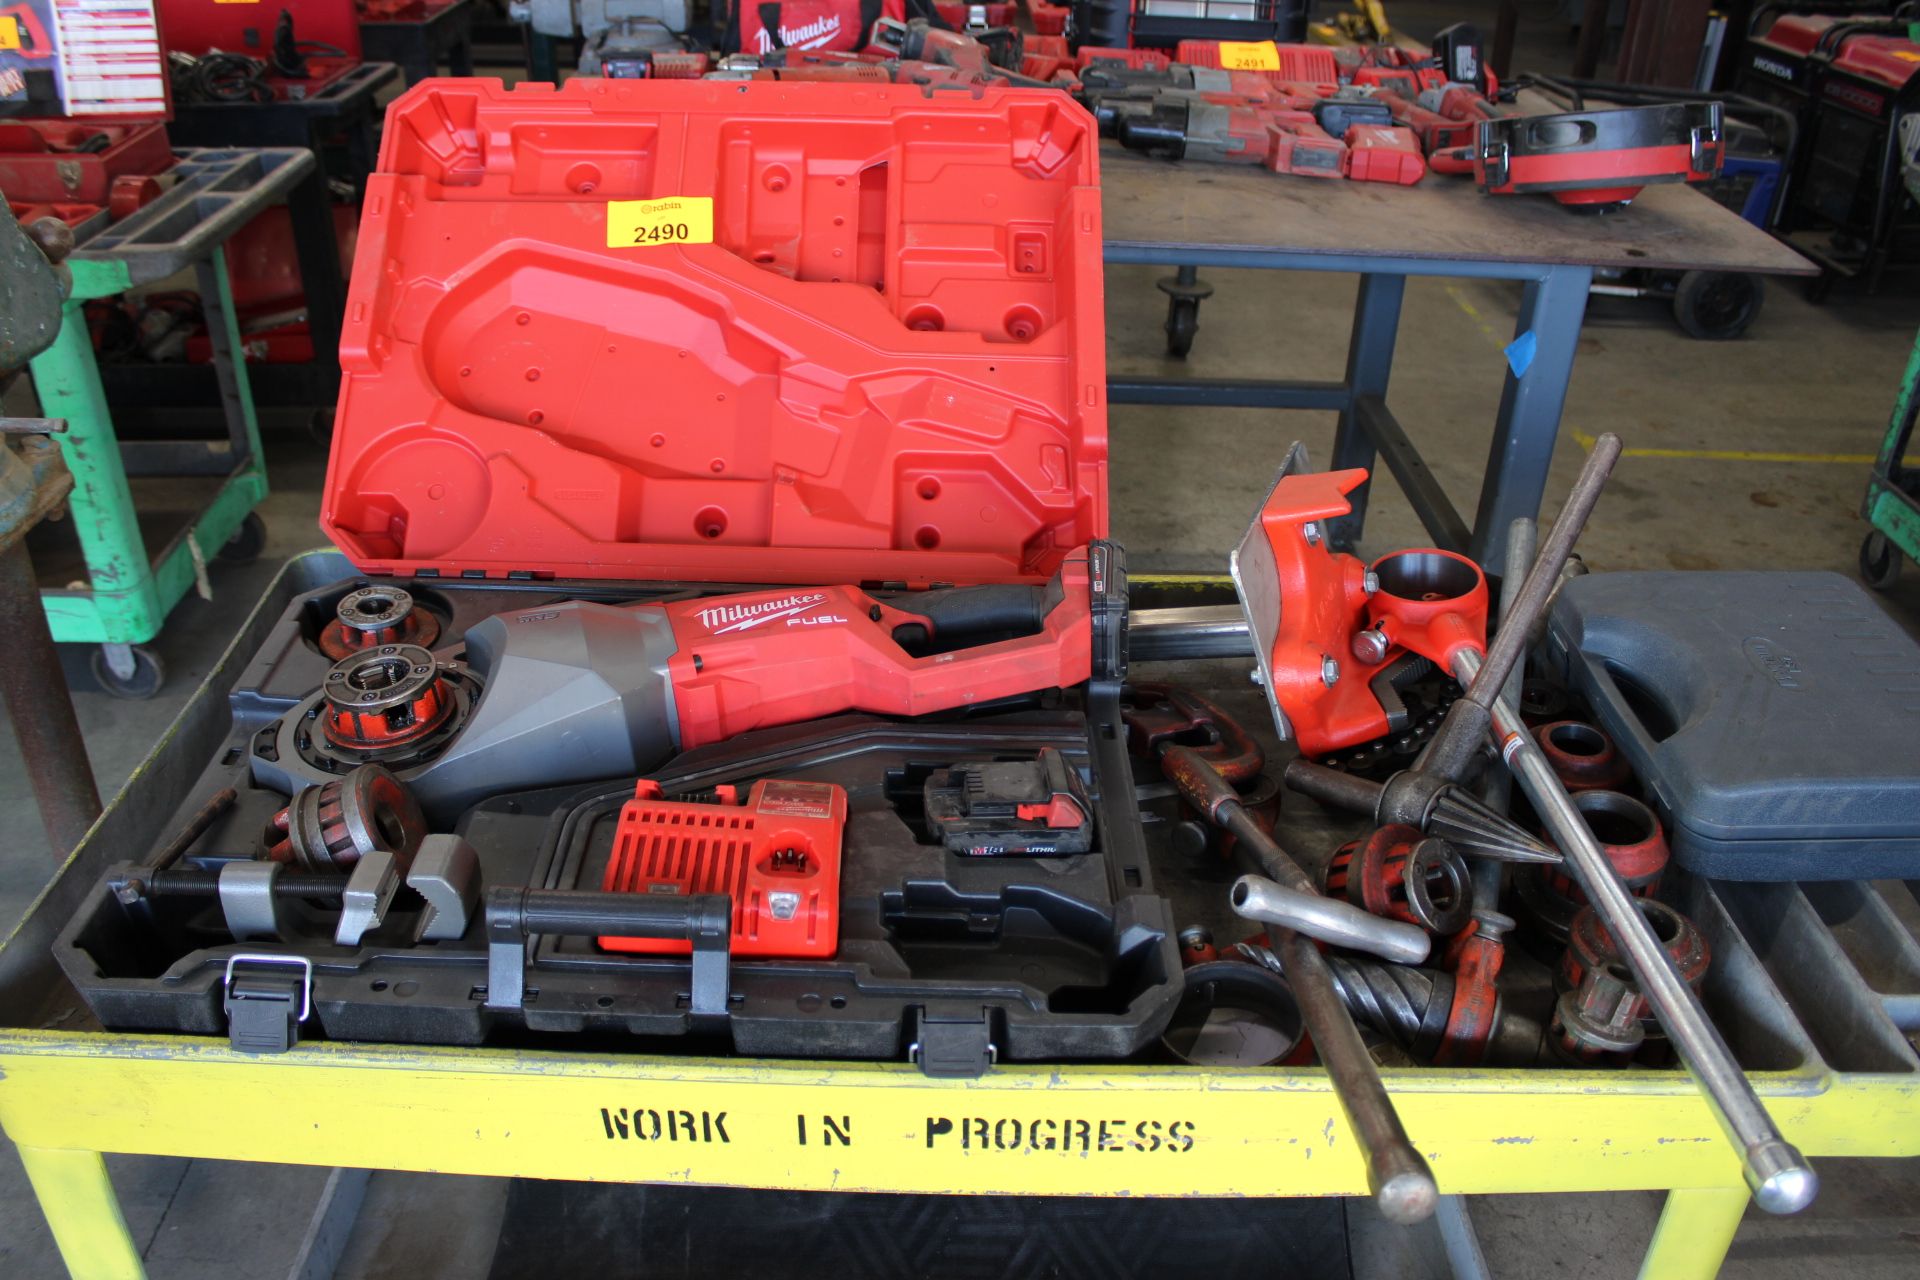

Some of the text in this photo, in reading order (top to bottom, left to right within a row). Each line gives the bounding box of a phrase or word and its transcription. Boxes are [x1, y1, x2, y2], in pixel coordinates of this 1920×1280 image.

[1235, 58, 1265, 69] 2491
[1752, 56, 1793, 80] HONDA
[633, 223, 689, 243] 2490
[694, 593, 827, 629] Milwaukee
[786, 615, 848, 627] FUEL
[601, 1108, 1196, 1152] WORK IN PROGRESS
